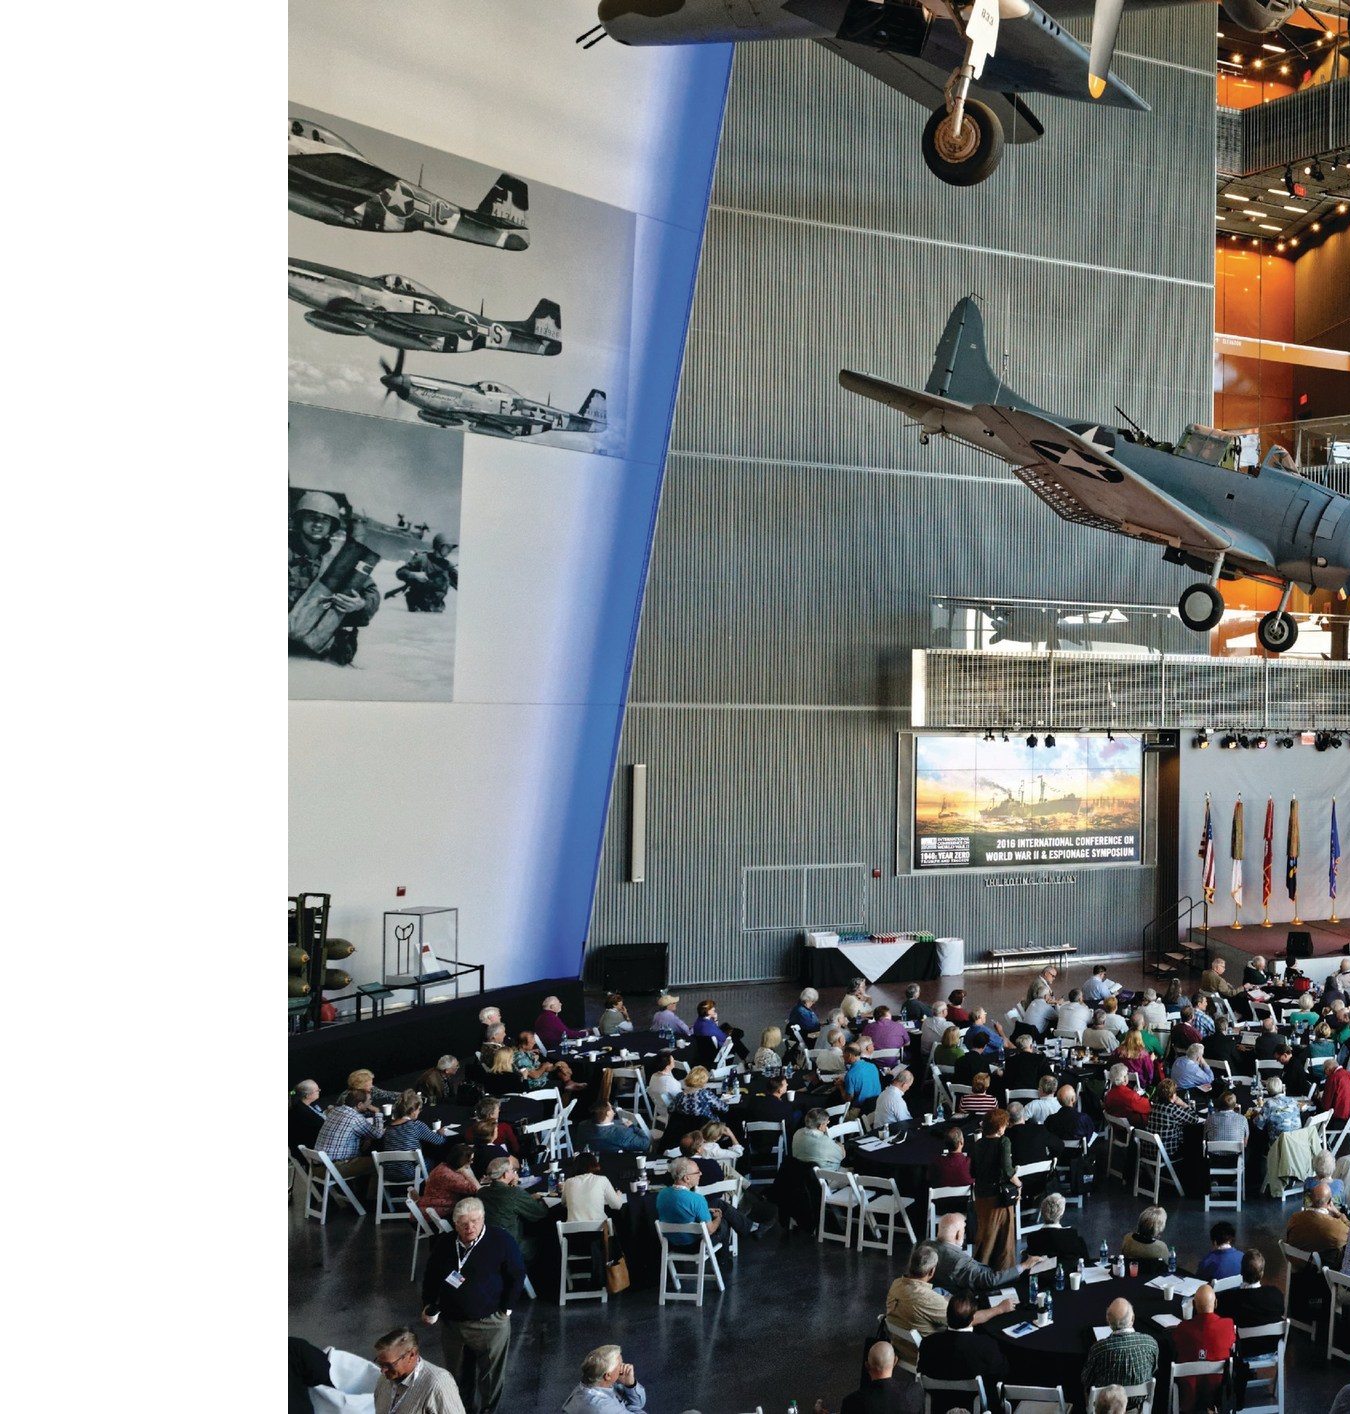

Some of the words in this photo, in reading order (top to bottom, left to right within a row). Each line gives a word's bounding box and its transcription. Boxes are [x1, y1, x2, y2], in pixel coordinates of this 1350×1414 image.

[435, 199, 449, 226] C
[493, 324, 504, 344] S
[996, 838, 1016, 849] 2016
[1017, 837, 1074, 848] INTERNATIONAL
[1075, 836, 1123, 847] CONFERENCE
[1124, 835, 1134, 844] ON
[938, 851, 954, 860] YEAR
[954, 851, 970, 859] ZERO
[985, 851, 1014, 862] WORLD
[1014, 850, 1032, 860] WAR
[1033, 850, 1040, 860] II
[1040, 849, 1048, 860] &
[1048, 848, 1090, 860] ESPIONAGE
[1091, 847, 1134, 858] SYMPOSIUM
